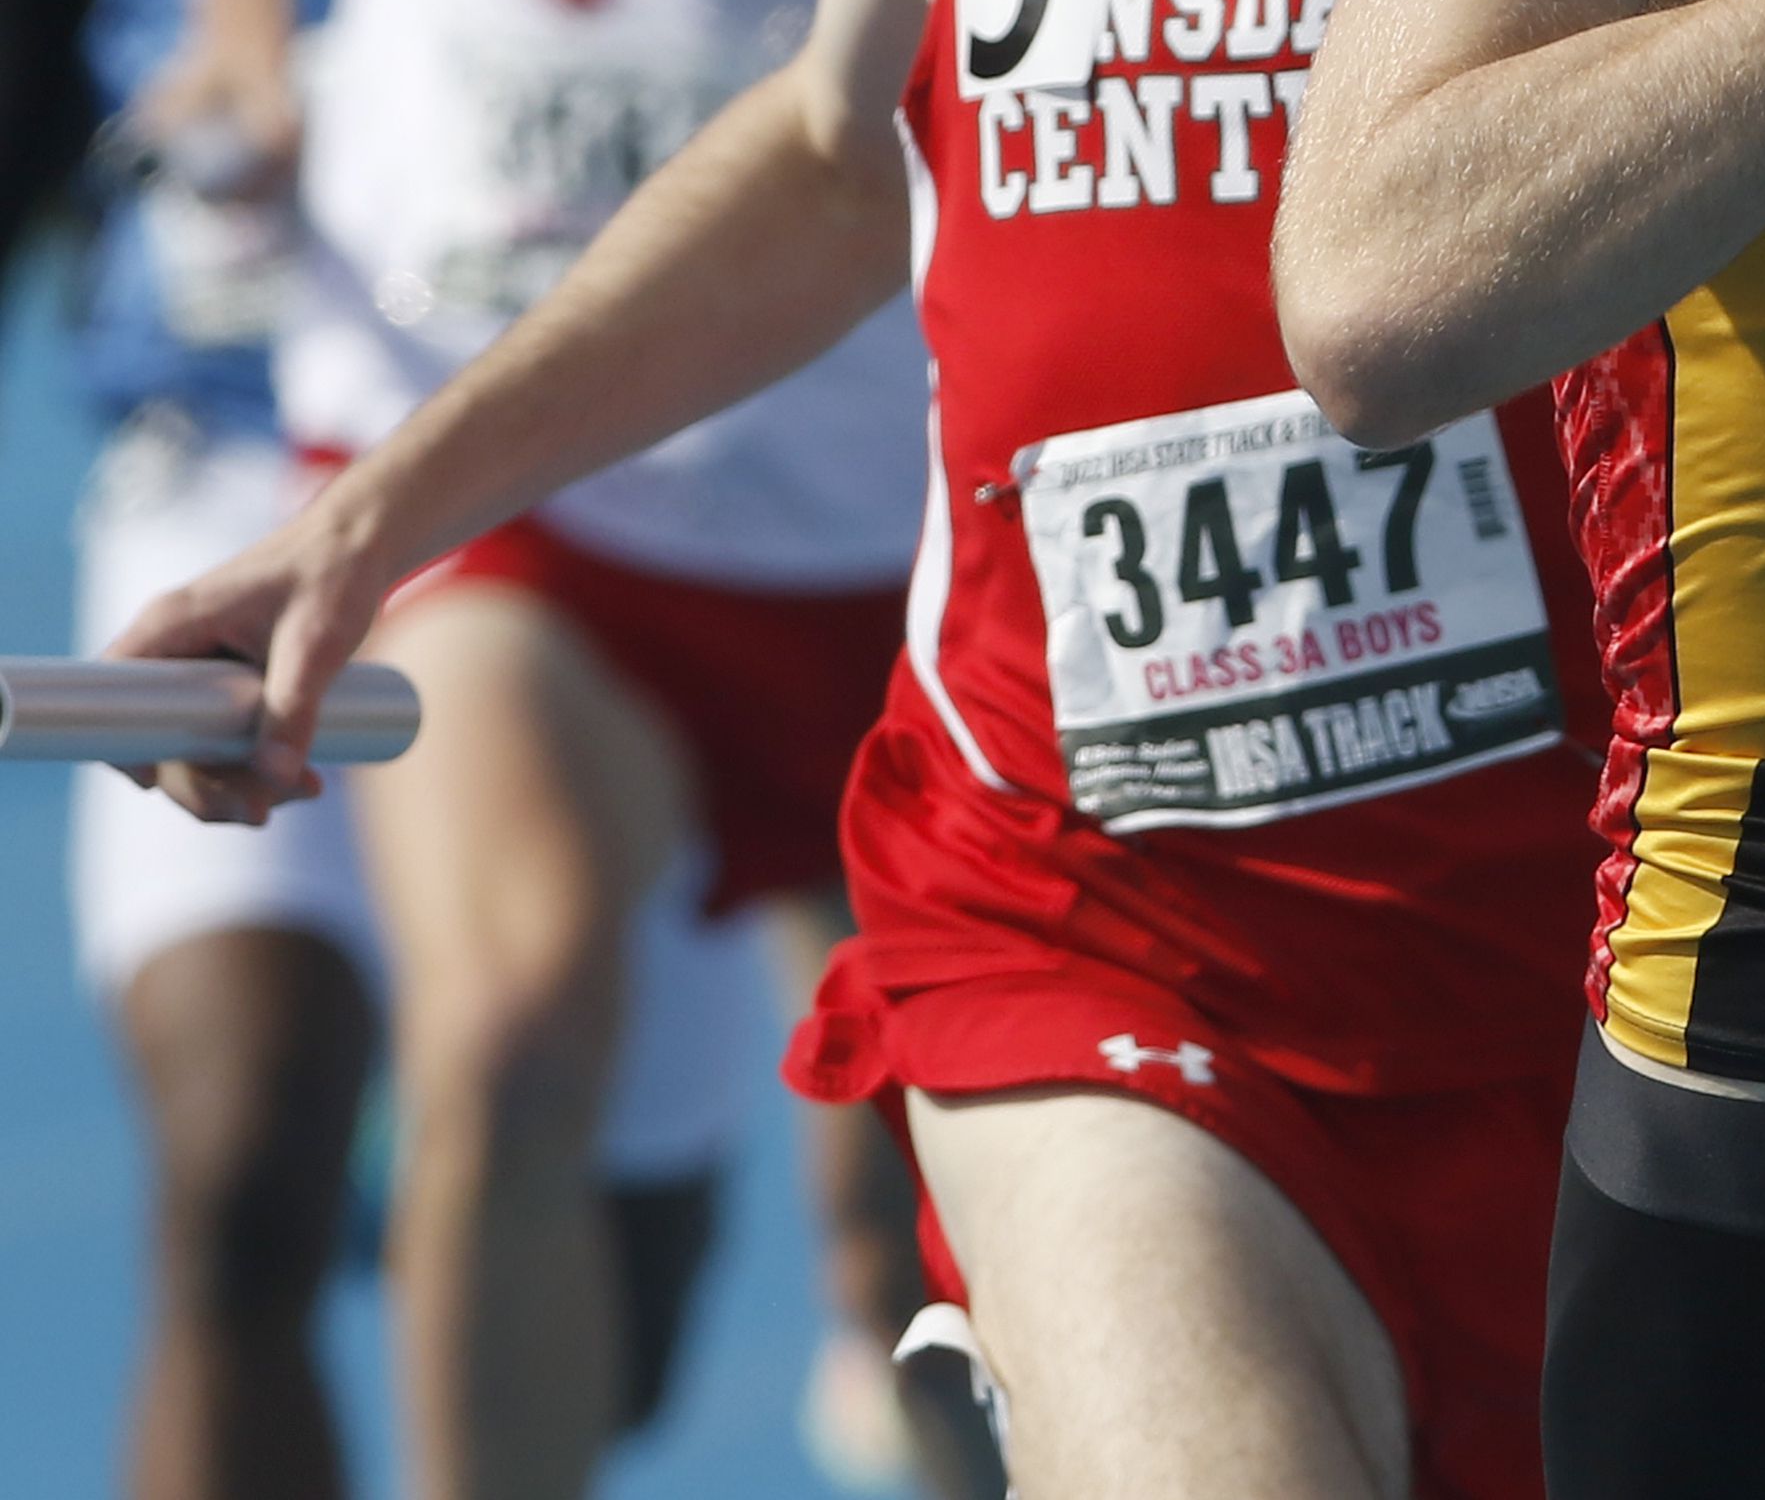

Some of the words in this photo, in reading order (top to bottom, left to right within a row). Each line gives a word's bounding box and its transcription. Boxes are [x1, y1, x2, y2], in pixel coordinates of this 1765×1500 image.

[979, 68, 1308, 220] CENT
[1082, 440, 1435, 649] 3447
[1144, 640, 1264, 700] CLASS
[1274, 628, 1326, 674] 3A
[1336, 601, 1442, 661] BOYS
[1302, 682, 1451, 778] TRACK
